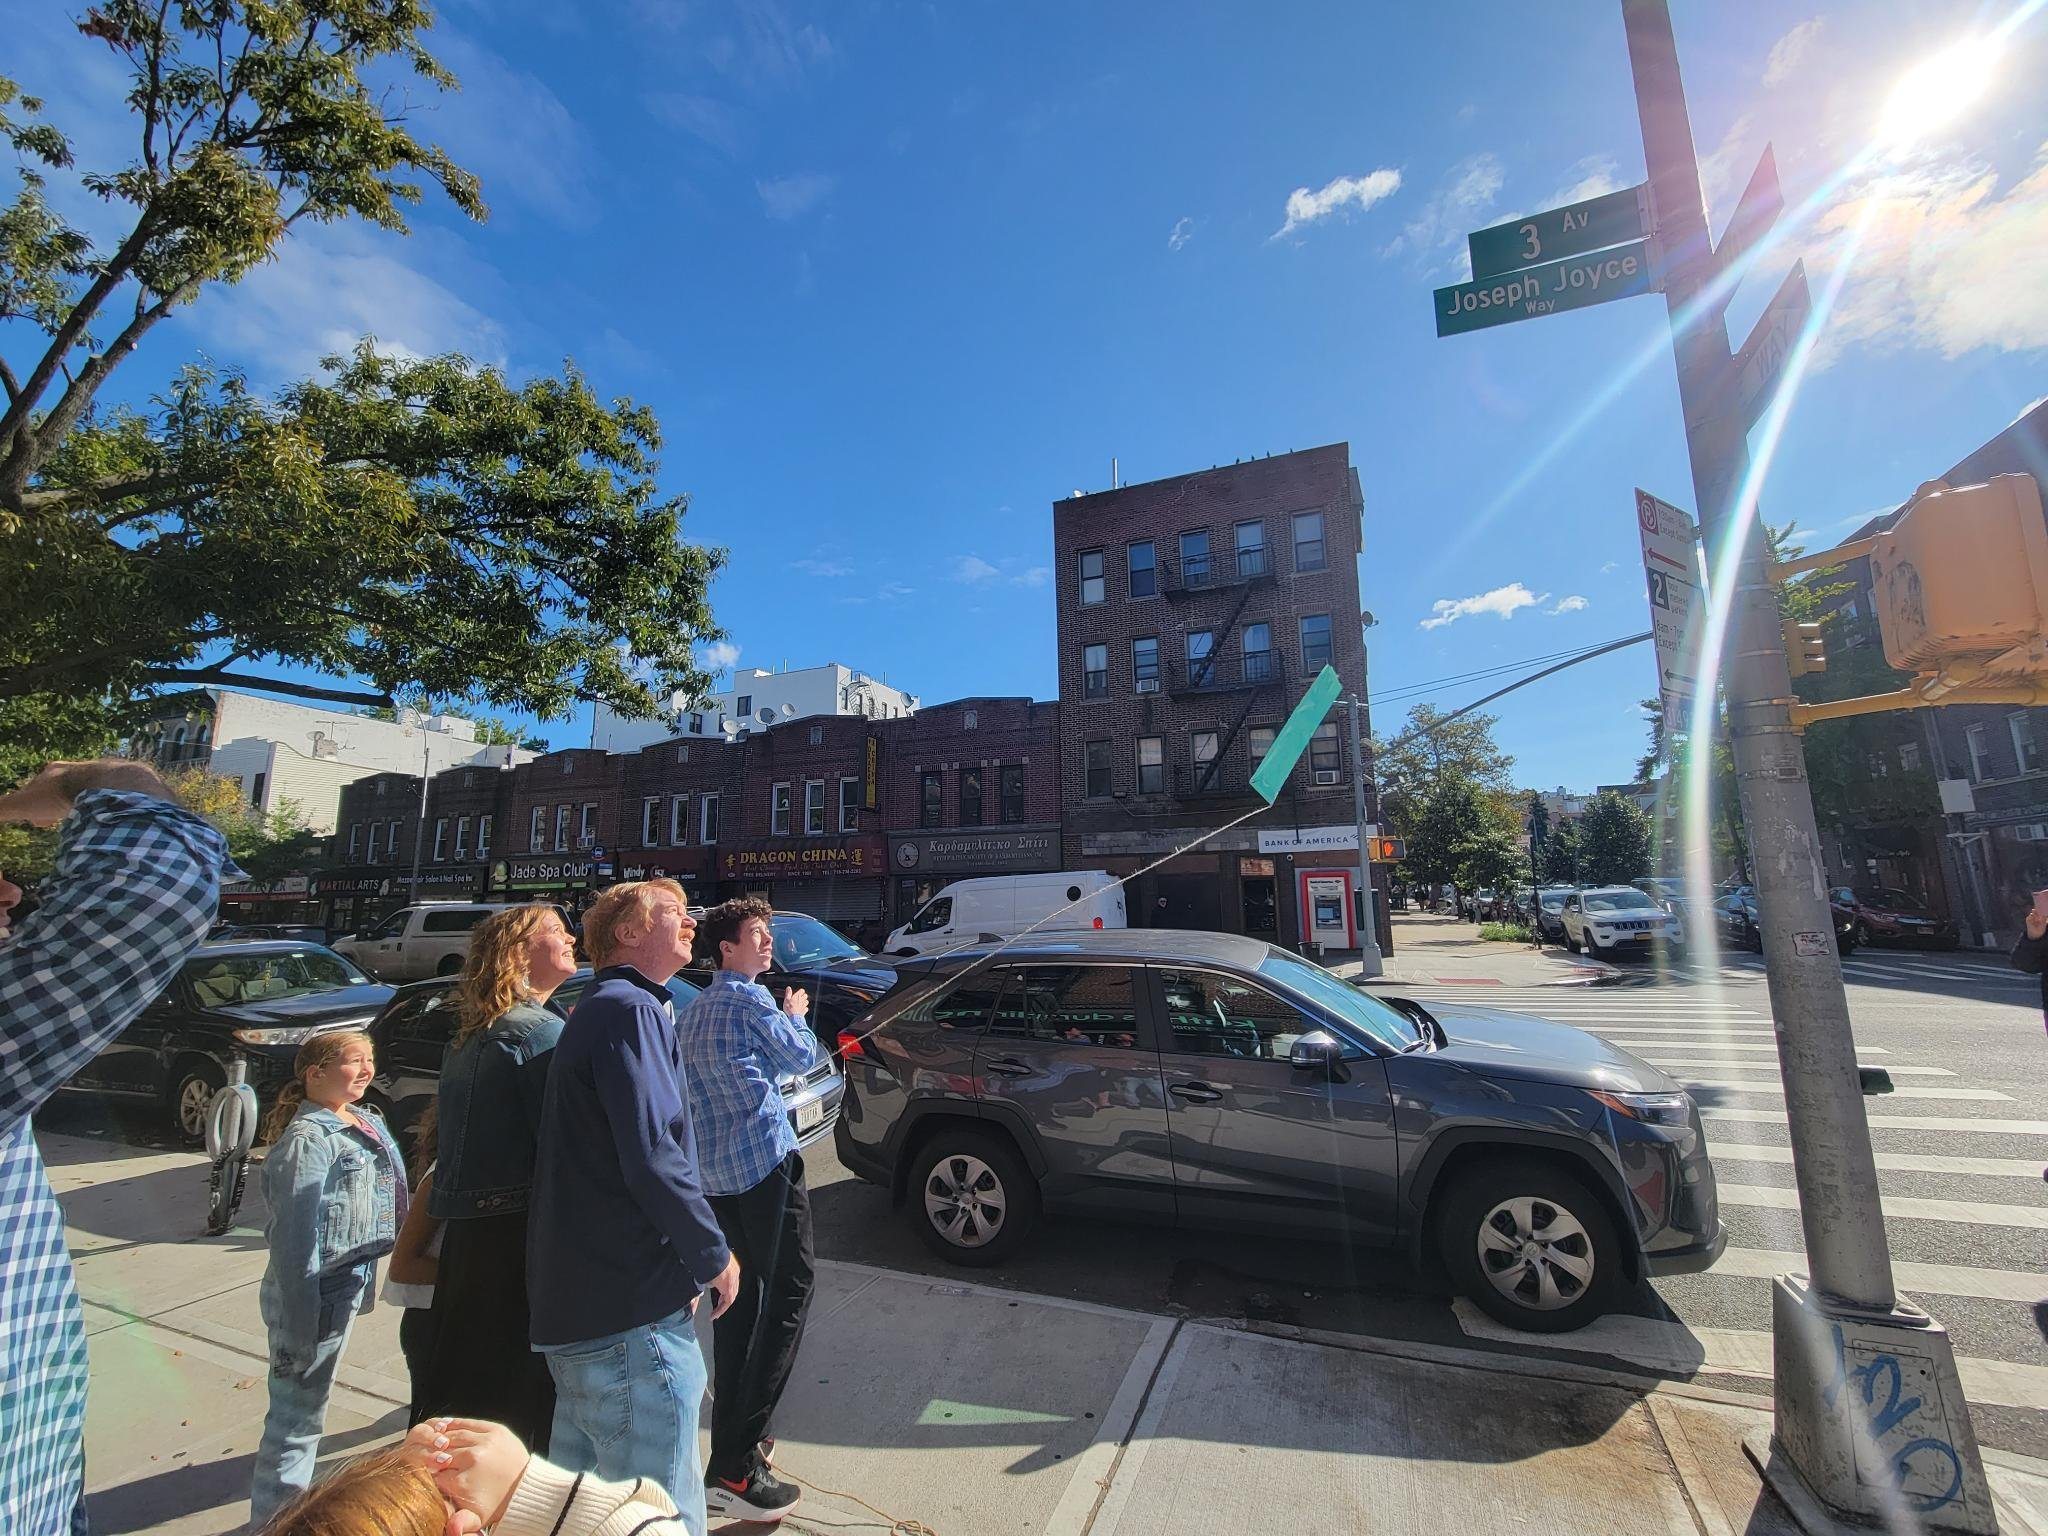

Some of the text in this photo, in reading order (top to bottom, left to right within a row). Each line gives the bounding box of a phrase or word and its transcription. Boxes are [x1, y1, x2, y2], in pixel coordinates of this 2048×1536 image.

[1519, 209, 1589, 260] 3 Av
[1447, 253, 1639, 315] Joseph Joyce
[1523, 298, 1556, 315] Way
[1653, 574, 1665, 605] 2
[1264, 839, 1290, 847] BANK
[1305, 836, 1349, 846] AMERICA
[740, 848, 848, 865] DRAGON CHINA
[510, 861, 589, 881] Jade Spa Club
[623, 864, 646, 880] Windy
[320, 880, 358, 892] MARTIAL
[357, 879, 379, 891] ARTS
